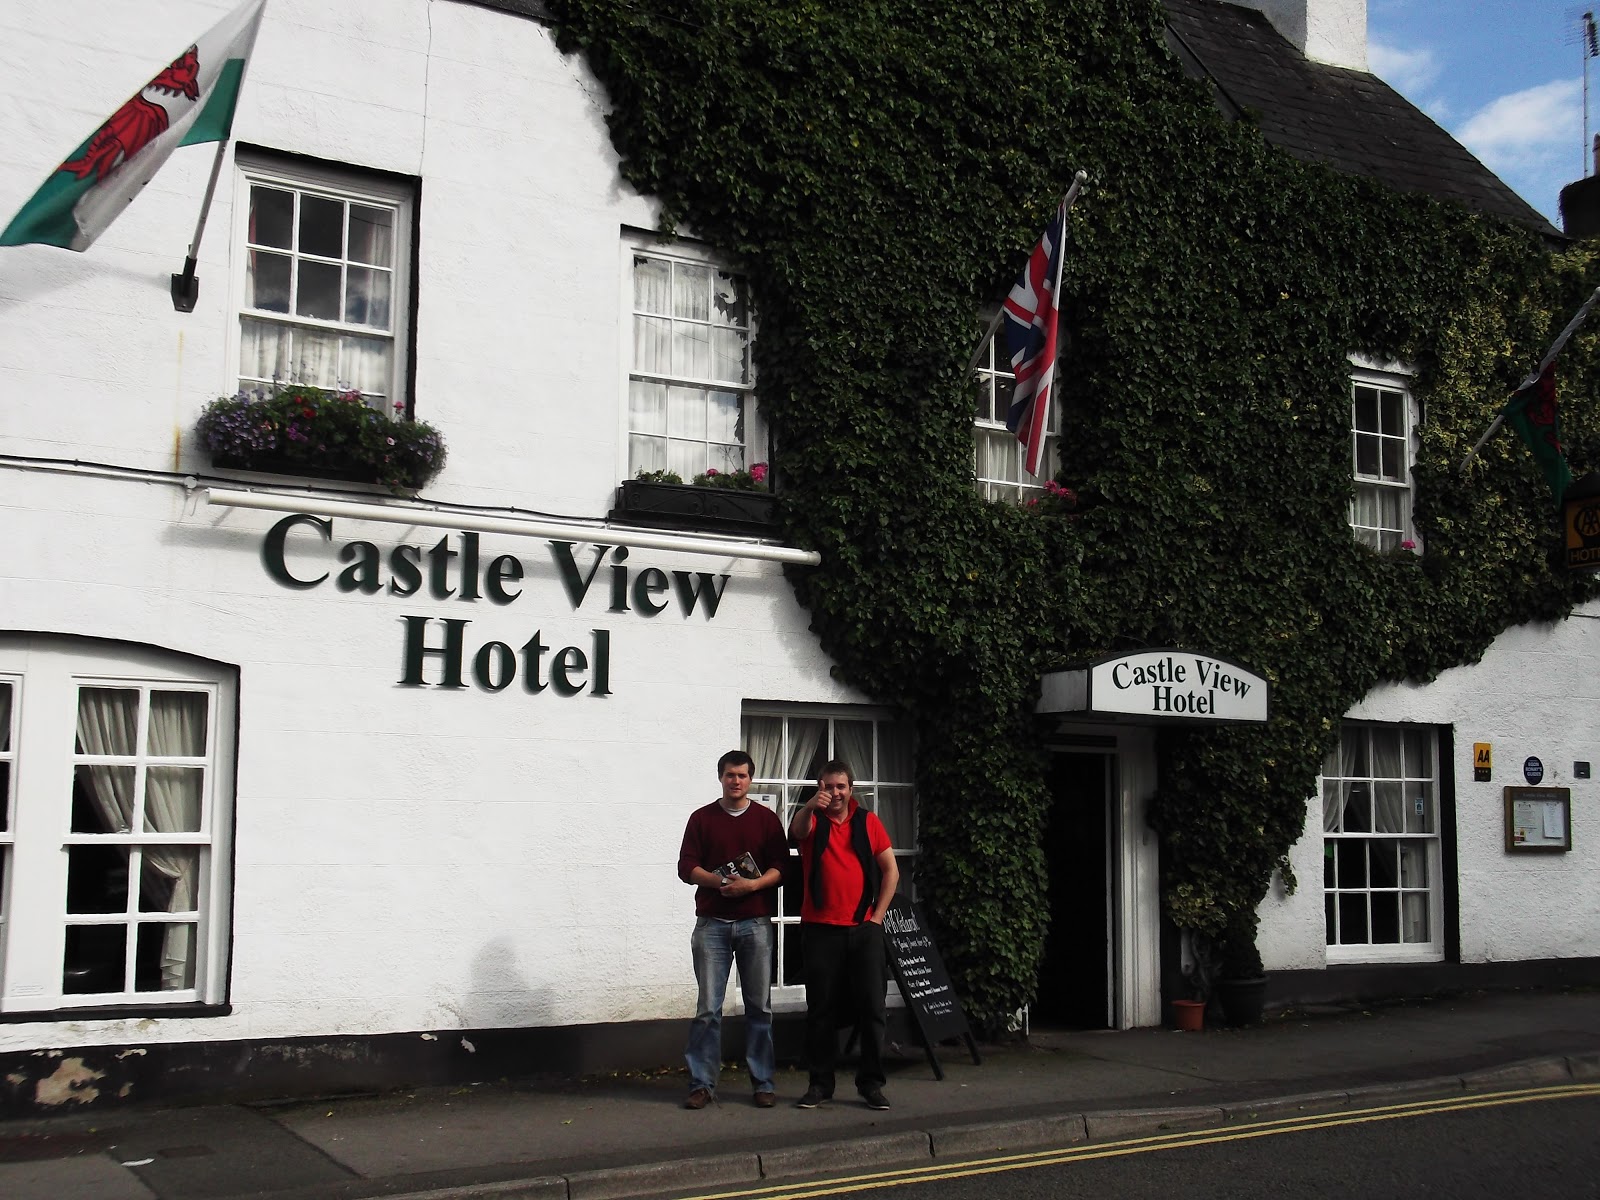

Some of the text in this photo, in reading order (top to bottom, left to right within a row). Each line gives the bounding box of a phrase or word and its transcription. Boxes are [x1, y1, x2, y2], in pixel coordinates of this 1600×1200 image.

[263, 514, 731, 619] Castle View
[396, 615, 613, 698] Hotel
[1112, 657, 1251, 699] Castle View
[1152, 685, 1216, 714] Hotel
[1477, 749, 1490, 763] AA
[726, 861, 741, 877] PU
